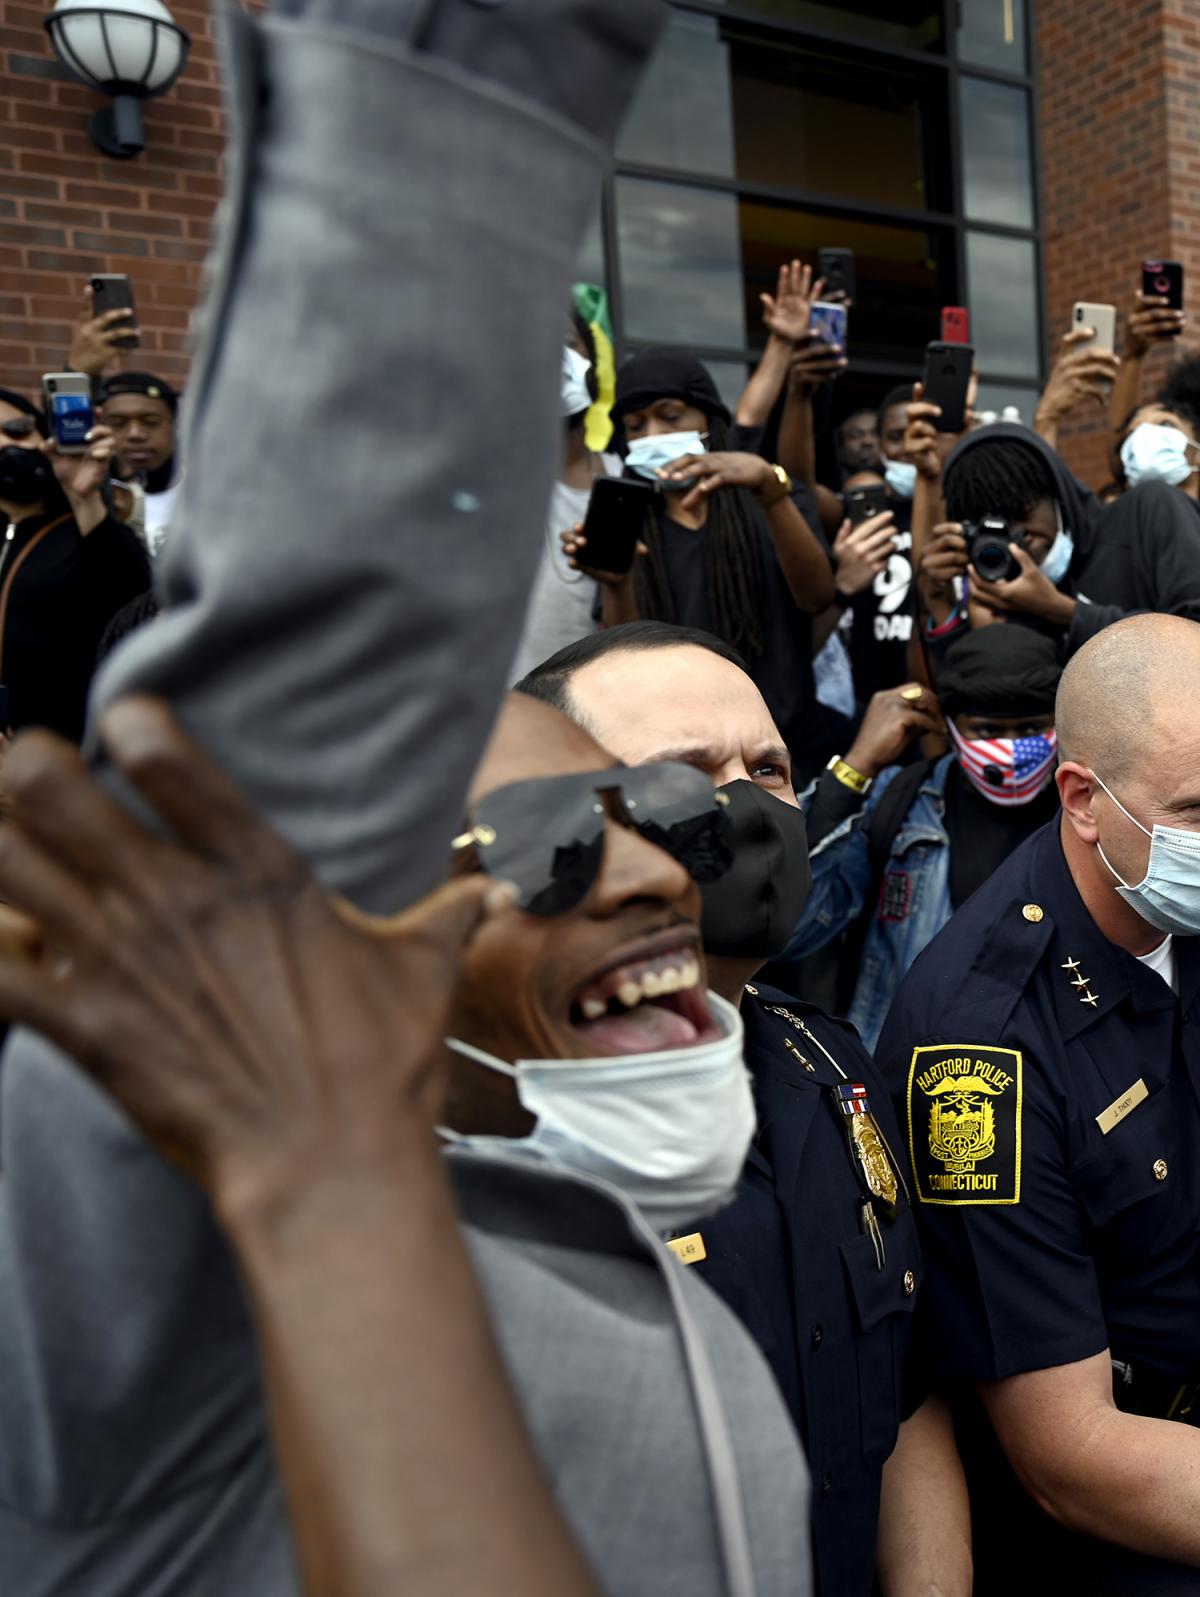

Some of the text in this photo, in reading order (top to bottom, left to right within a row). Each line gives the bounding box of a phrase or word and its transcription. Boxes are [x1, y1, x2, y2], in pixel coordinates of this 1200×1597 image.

[916, 1058, 1014, 1091] HARTFORD POLICE
[928, 1174, 999, 1191] CONNECTICUT
